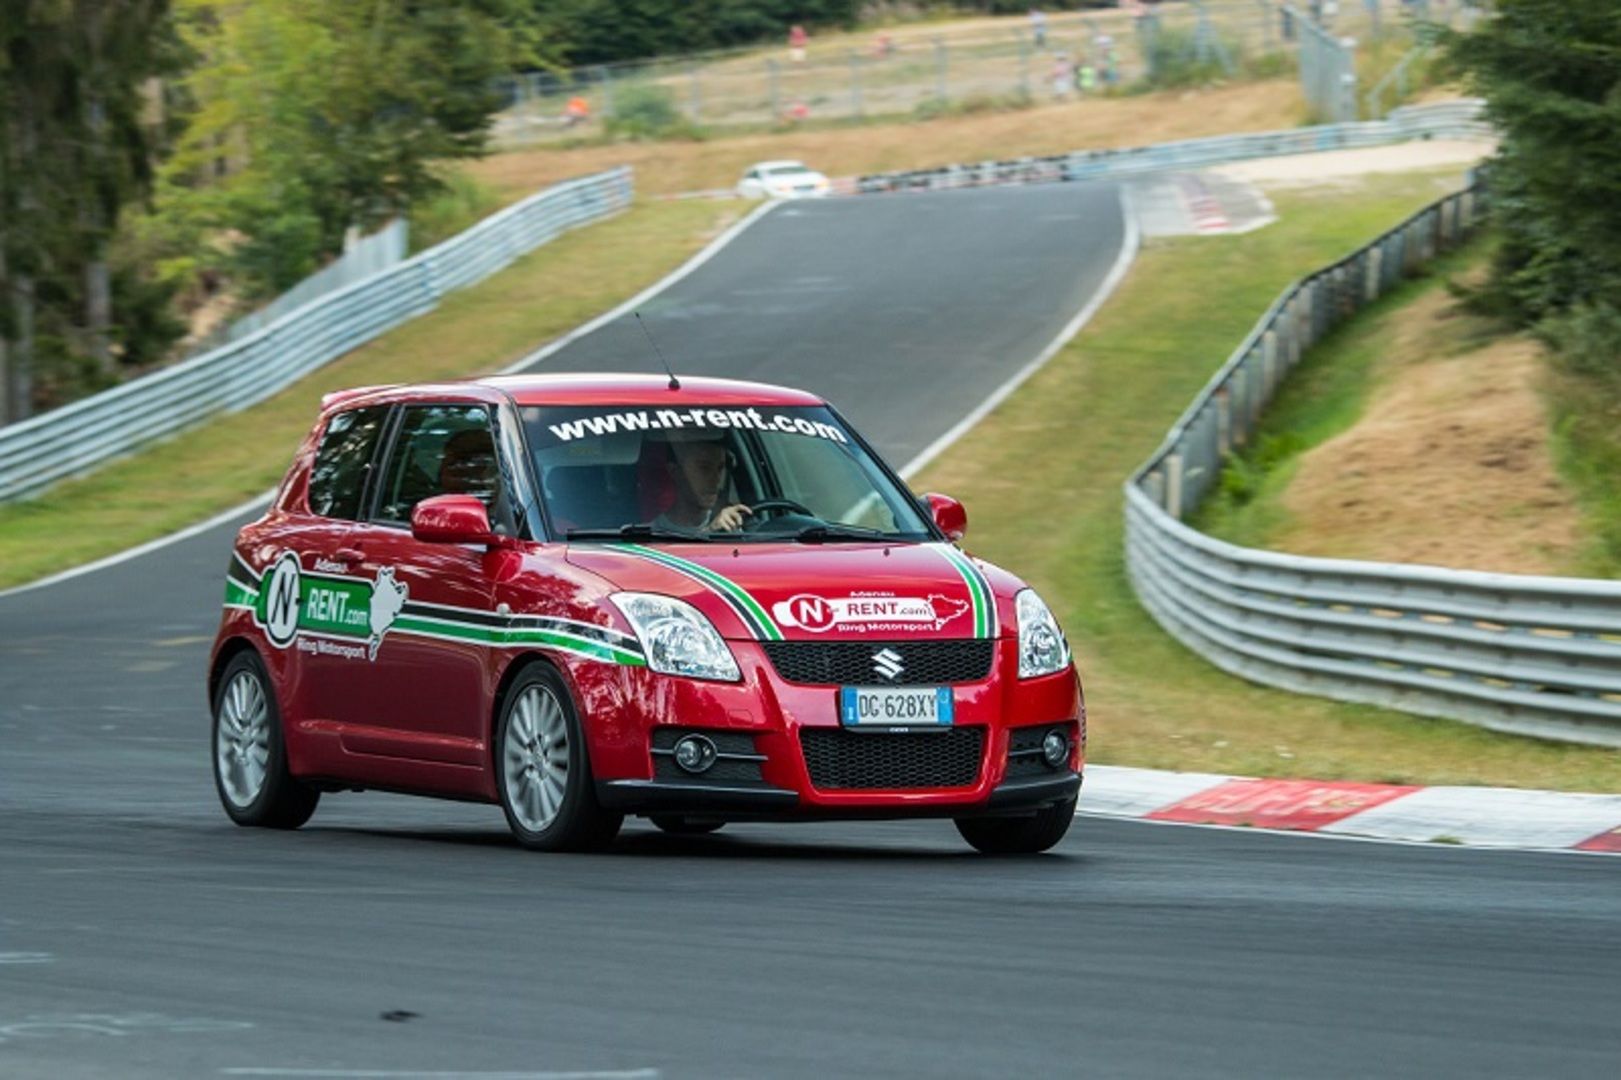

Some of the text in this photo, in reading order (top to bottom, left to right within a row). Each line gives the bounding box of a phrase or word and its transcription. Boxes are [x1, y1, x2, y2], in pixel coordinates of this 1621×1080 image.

[549, 407, 848, 443] www.n-rent.com
[307, 587, 368, 625] RENT.com
[847, 603, 927, 616] RENT.com
[884, 694, 936, 718] 628XY
